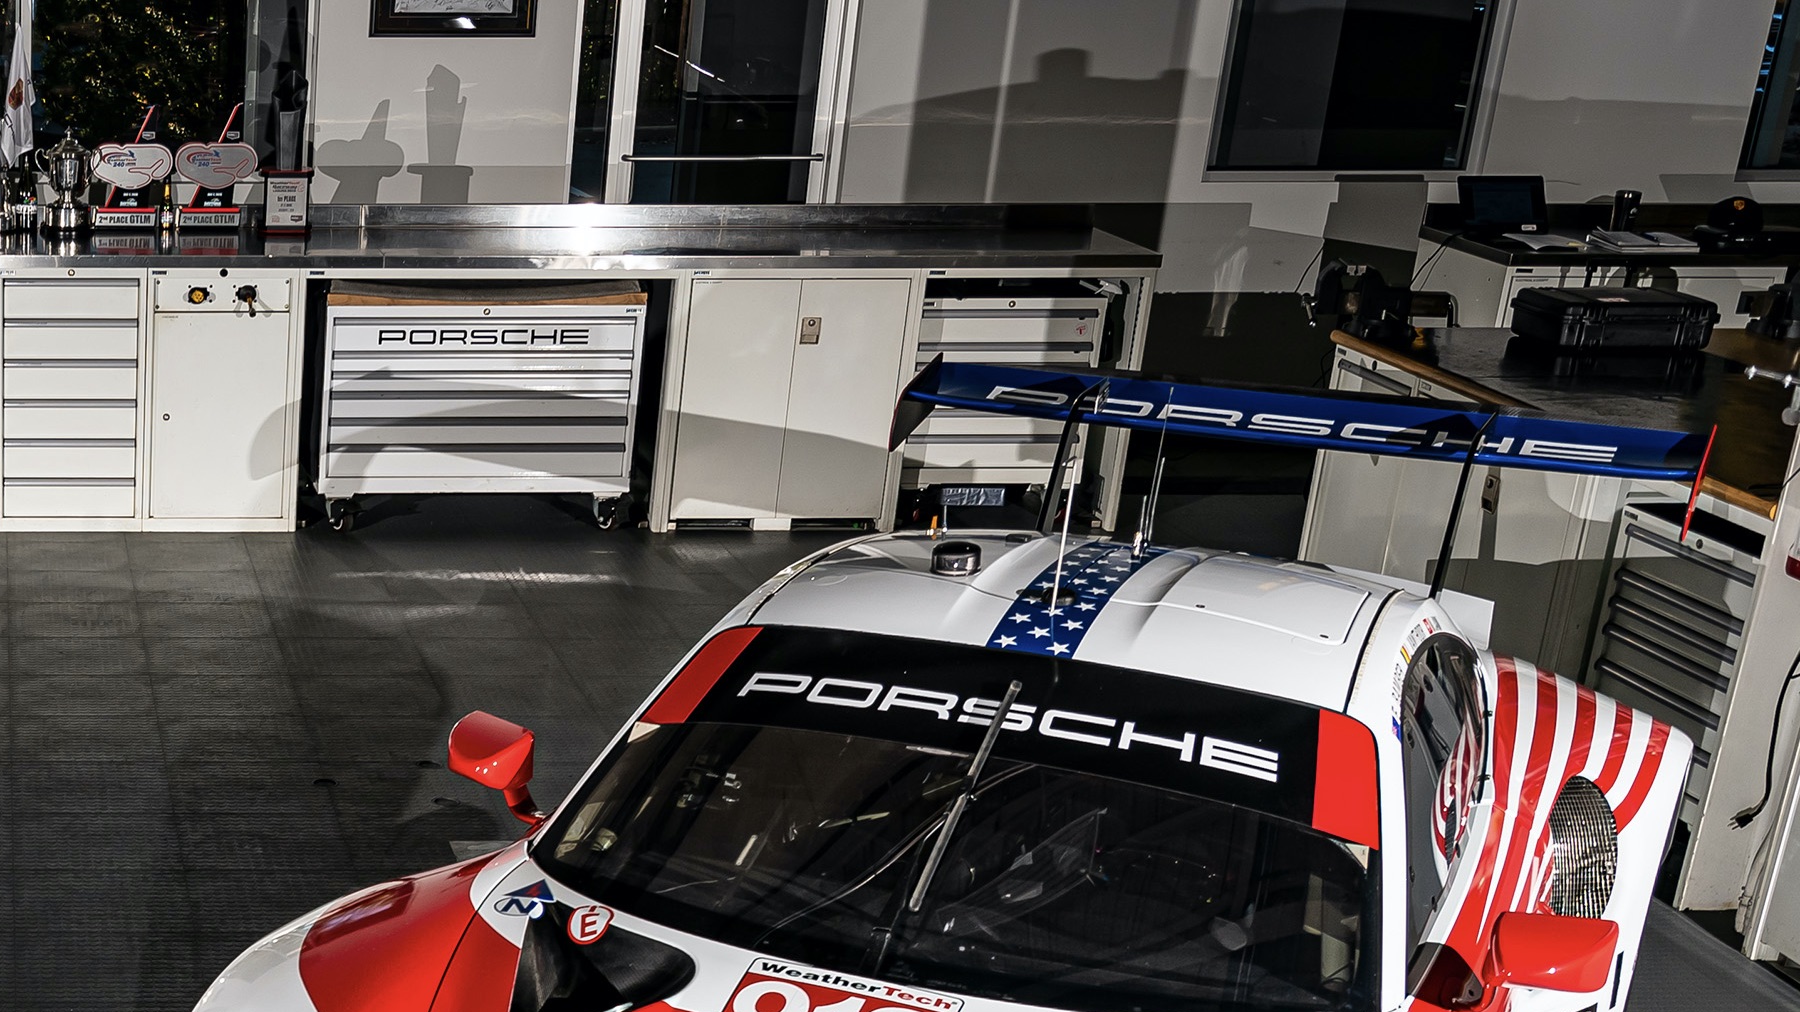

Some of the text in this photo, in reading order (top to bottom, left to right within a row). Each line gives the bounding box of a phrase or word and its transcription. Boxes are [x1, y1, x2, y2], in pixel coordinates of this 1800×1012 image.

[98, 215, 151, 224] 2nd PLACE GTLM
[182, 215, 235, 224] 2nd PLACE GTLM
[378, 329, 590, 346] PORSCHE
[986, 385, 1618, 463] PORSCHE
[737, 672, 1278, 783] PORSCHE
[760, 962, 956, 1010] WeatherTech
